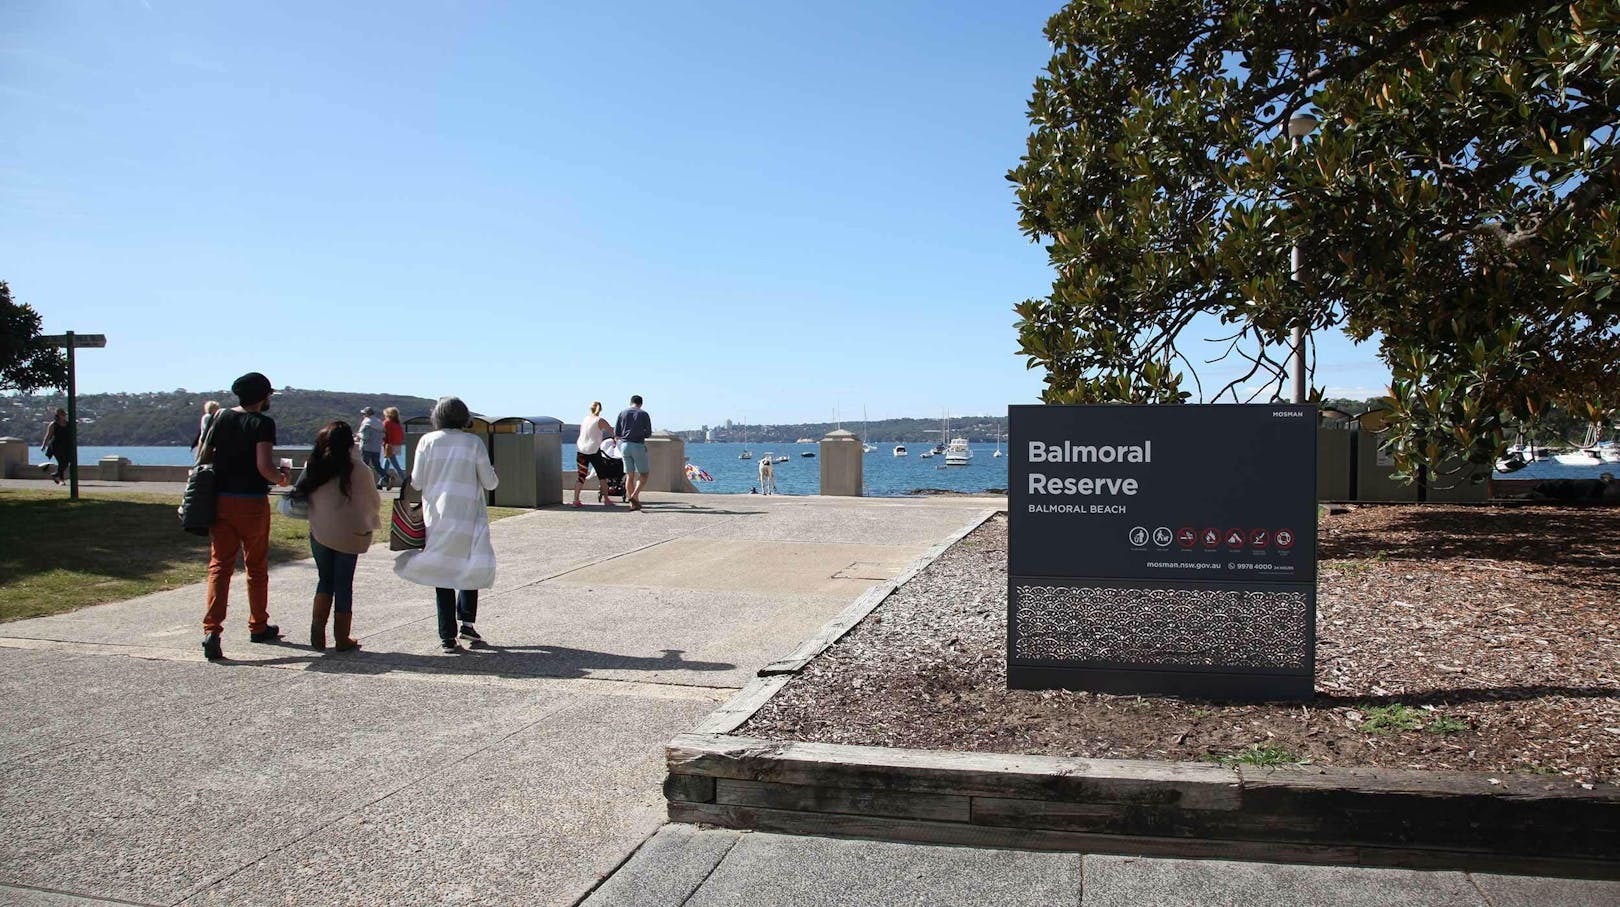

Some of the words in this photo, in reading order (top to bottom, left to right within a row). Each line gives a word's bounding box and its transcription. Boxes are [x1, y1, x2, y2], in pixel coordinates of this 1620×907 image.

[1028, 440, 1151, 463] Balmoral
[1028, 473, 1139, 496] Reserve
[1028, 504, 1087, 514] BALMORAL
[1090, 504, 1127, 514] BEACH
[1146, 561, 1222, 571] mosman.nsw.gov.au
[1236, 562, 1254, 570] 9978
